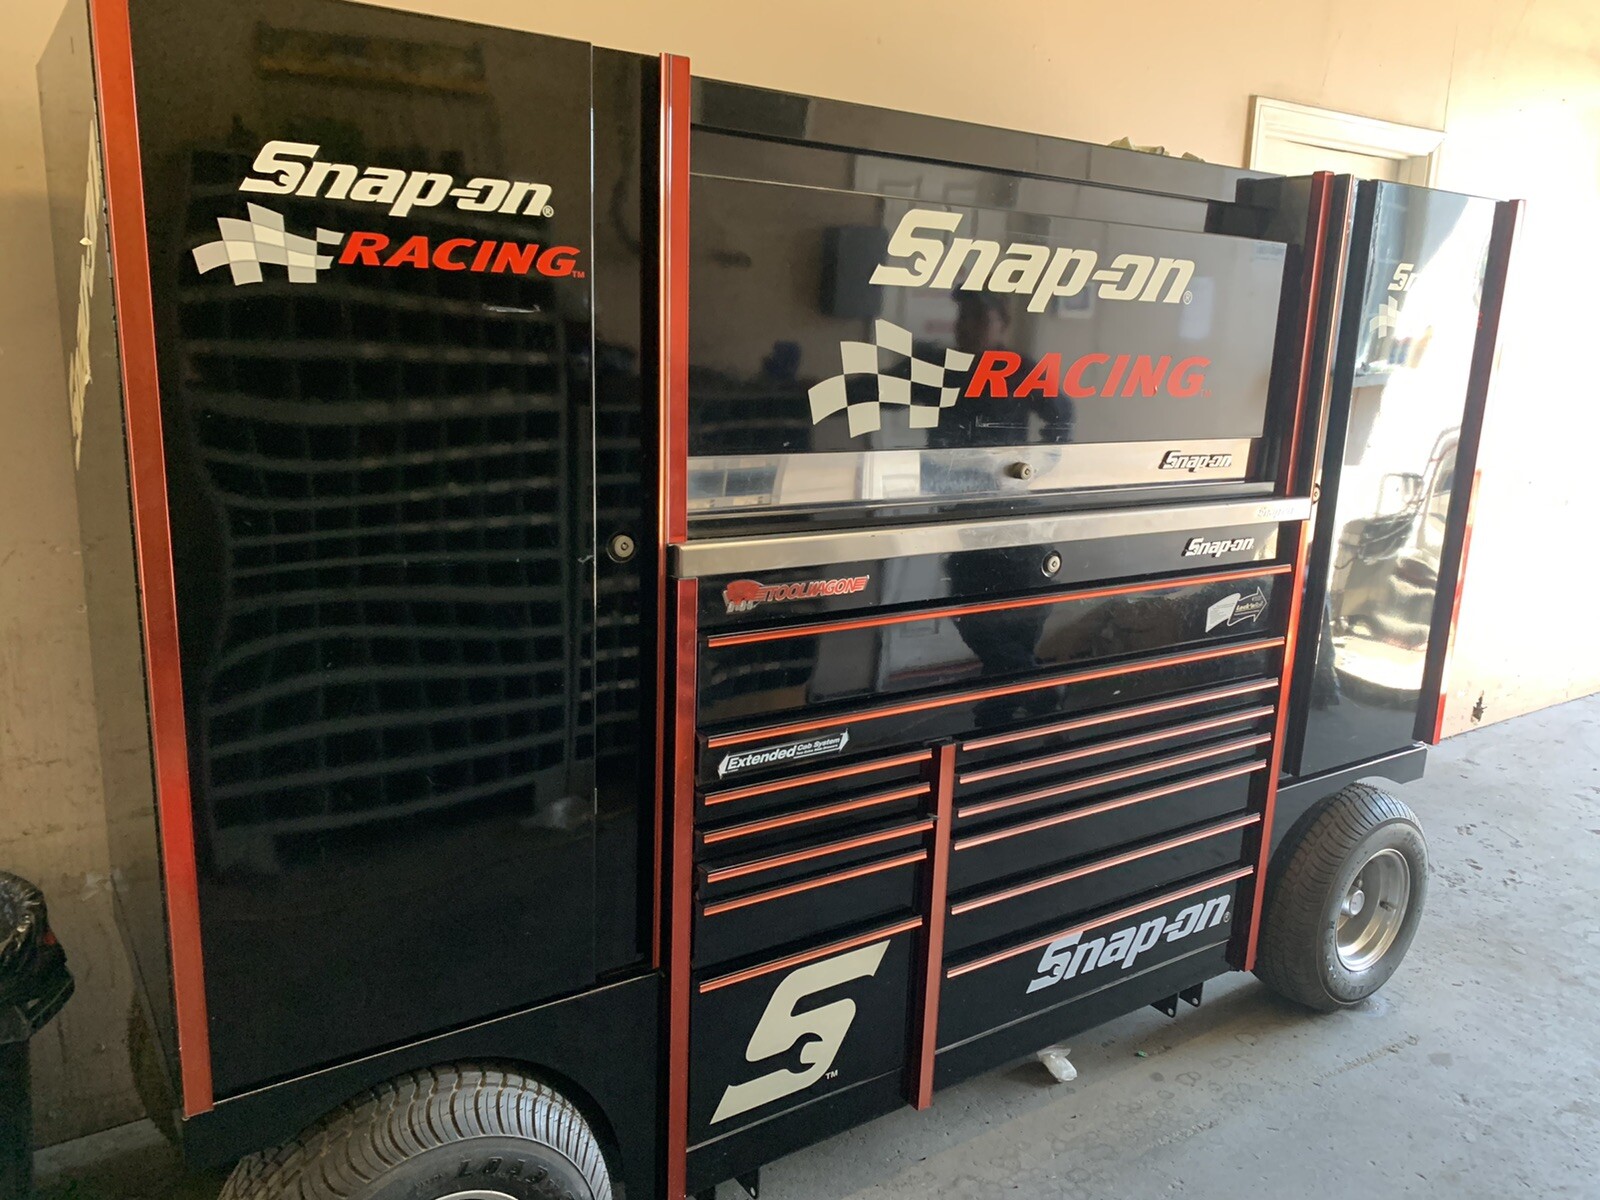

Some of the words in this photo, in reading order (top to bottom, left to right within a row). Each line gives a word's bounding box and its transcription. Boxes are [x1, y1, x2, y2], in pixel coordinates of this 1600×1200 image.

[238, 139, 553, 218] Snap-on
[338, 230, 582, 278] RACING
[868, 208, 1196, 314] Snap-on
[964, 349, 1211, 399] RACING
[1158, 449, 1233, 473] Snap-on
[1181, 536, 1255, 558] Snap-on
[727, 745, 797, 771] Extended
[1025, 893, 1232, 994] Snap-on
